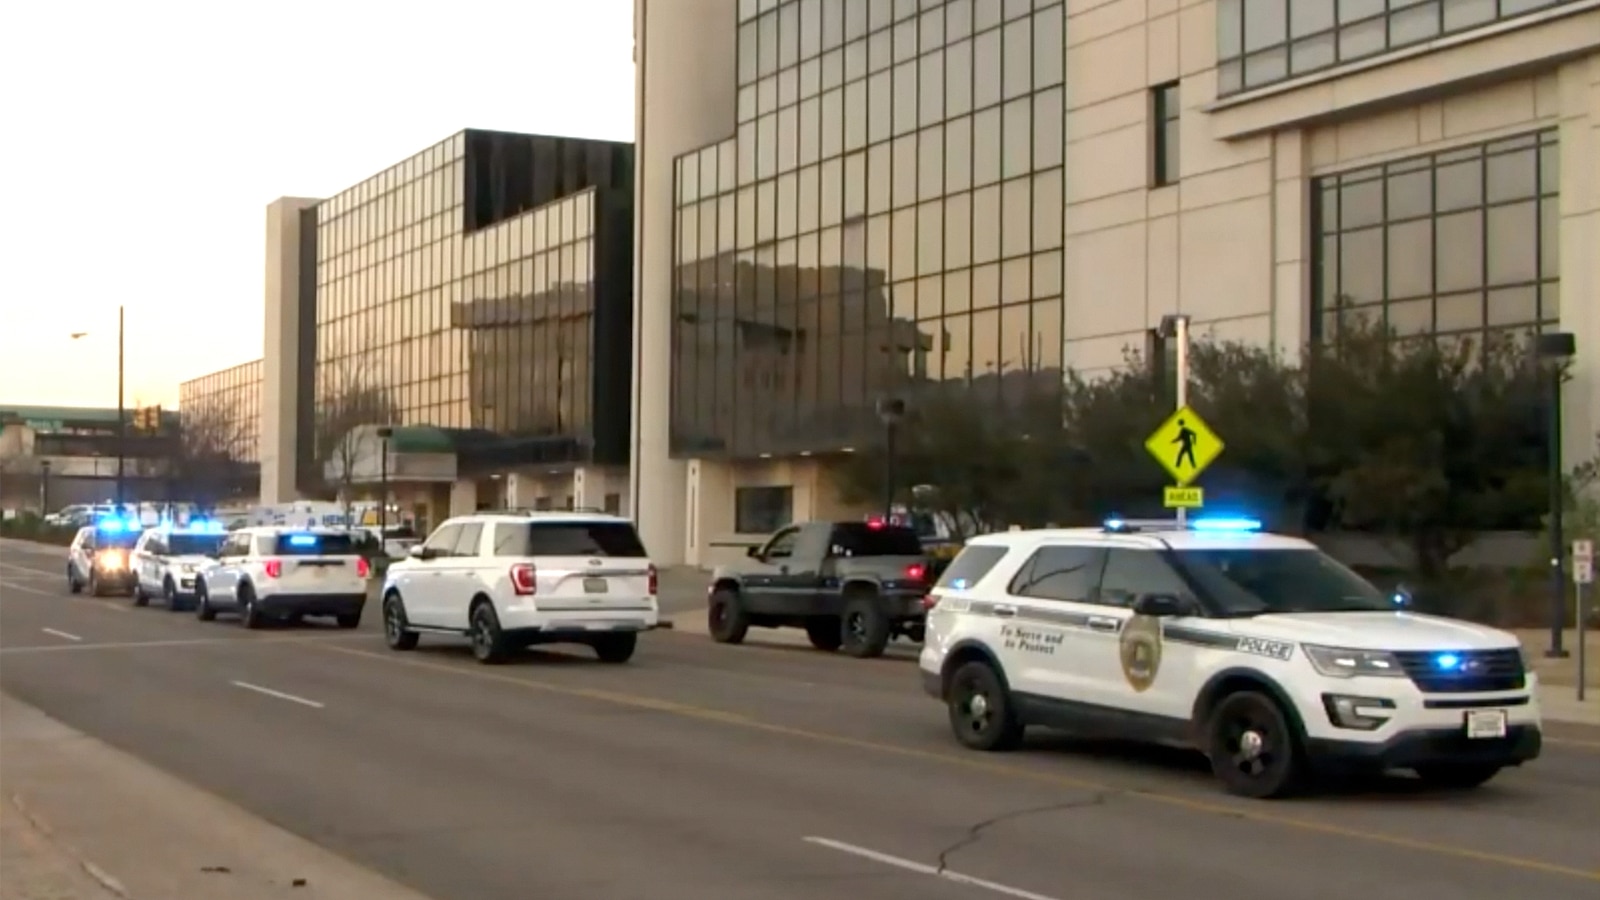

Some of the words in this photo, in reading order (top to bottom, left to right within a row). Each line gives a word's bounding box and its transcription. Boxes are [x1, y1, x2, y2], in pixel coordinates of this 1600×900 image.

[1170, 491, 1199, 501] AHEAD
[1000, 624, 1013, 636] To
[1016, 627, 1043, 642] Serve
[1045, 633, 1065, 645] and
[1019, 640, 1055, 655] Protect
[1240, 637, 1290, 659] POLICE
